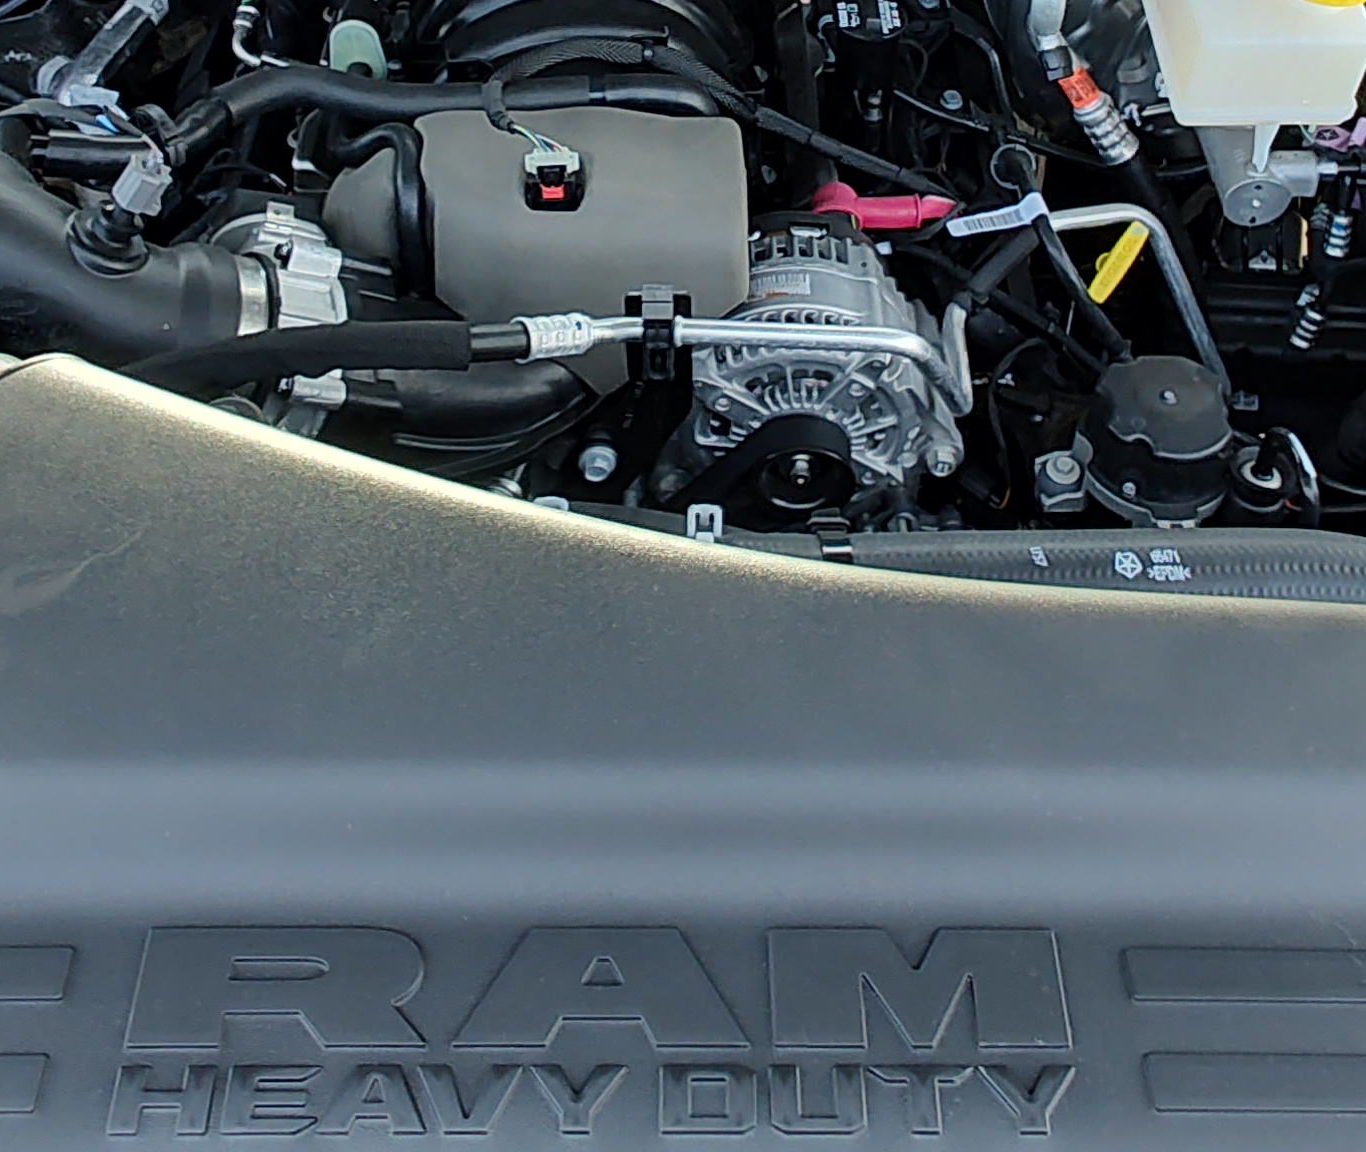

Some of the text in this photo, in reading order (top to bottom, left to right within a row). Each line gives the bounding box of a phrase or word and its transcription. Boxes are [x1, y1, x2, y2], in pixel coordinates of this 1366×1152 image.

[125, 925, 1074, 1051] RAM
[107, 1063, 1076, 1136] HEAVY DUTY
